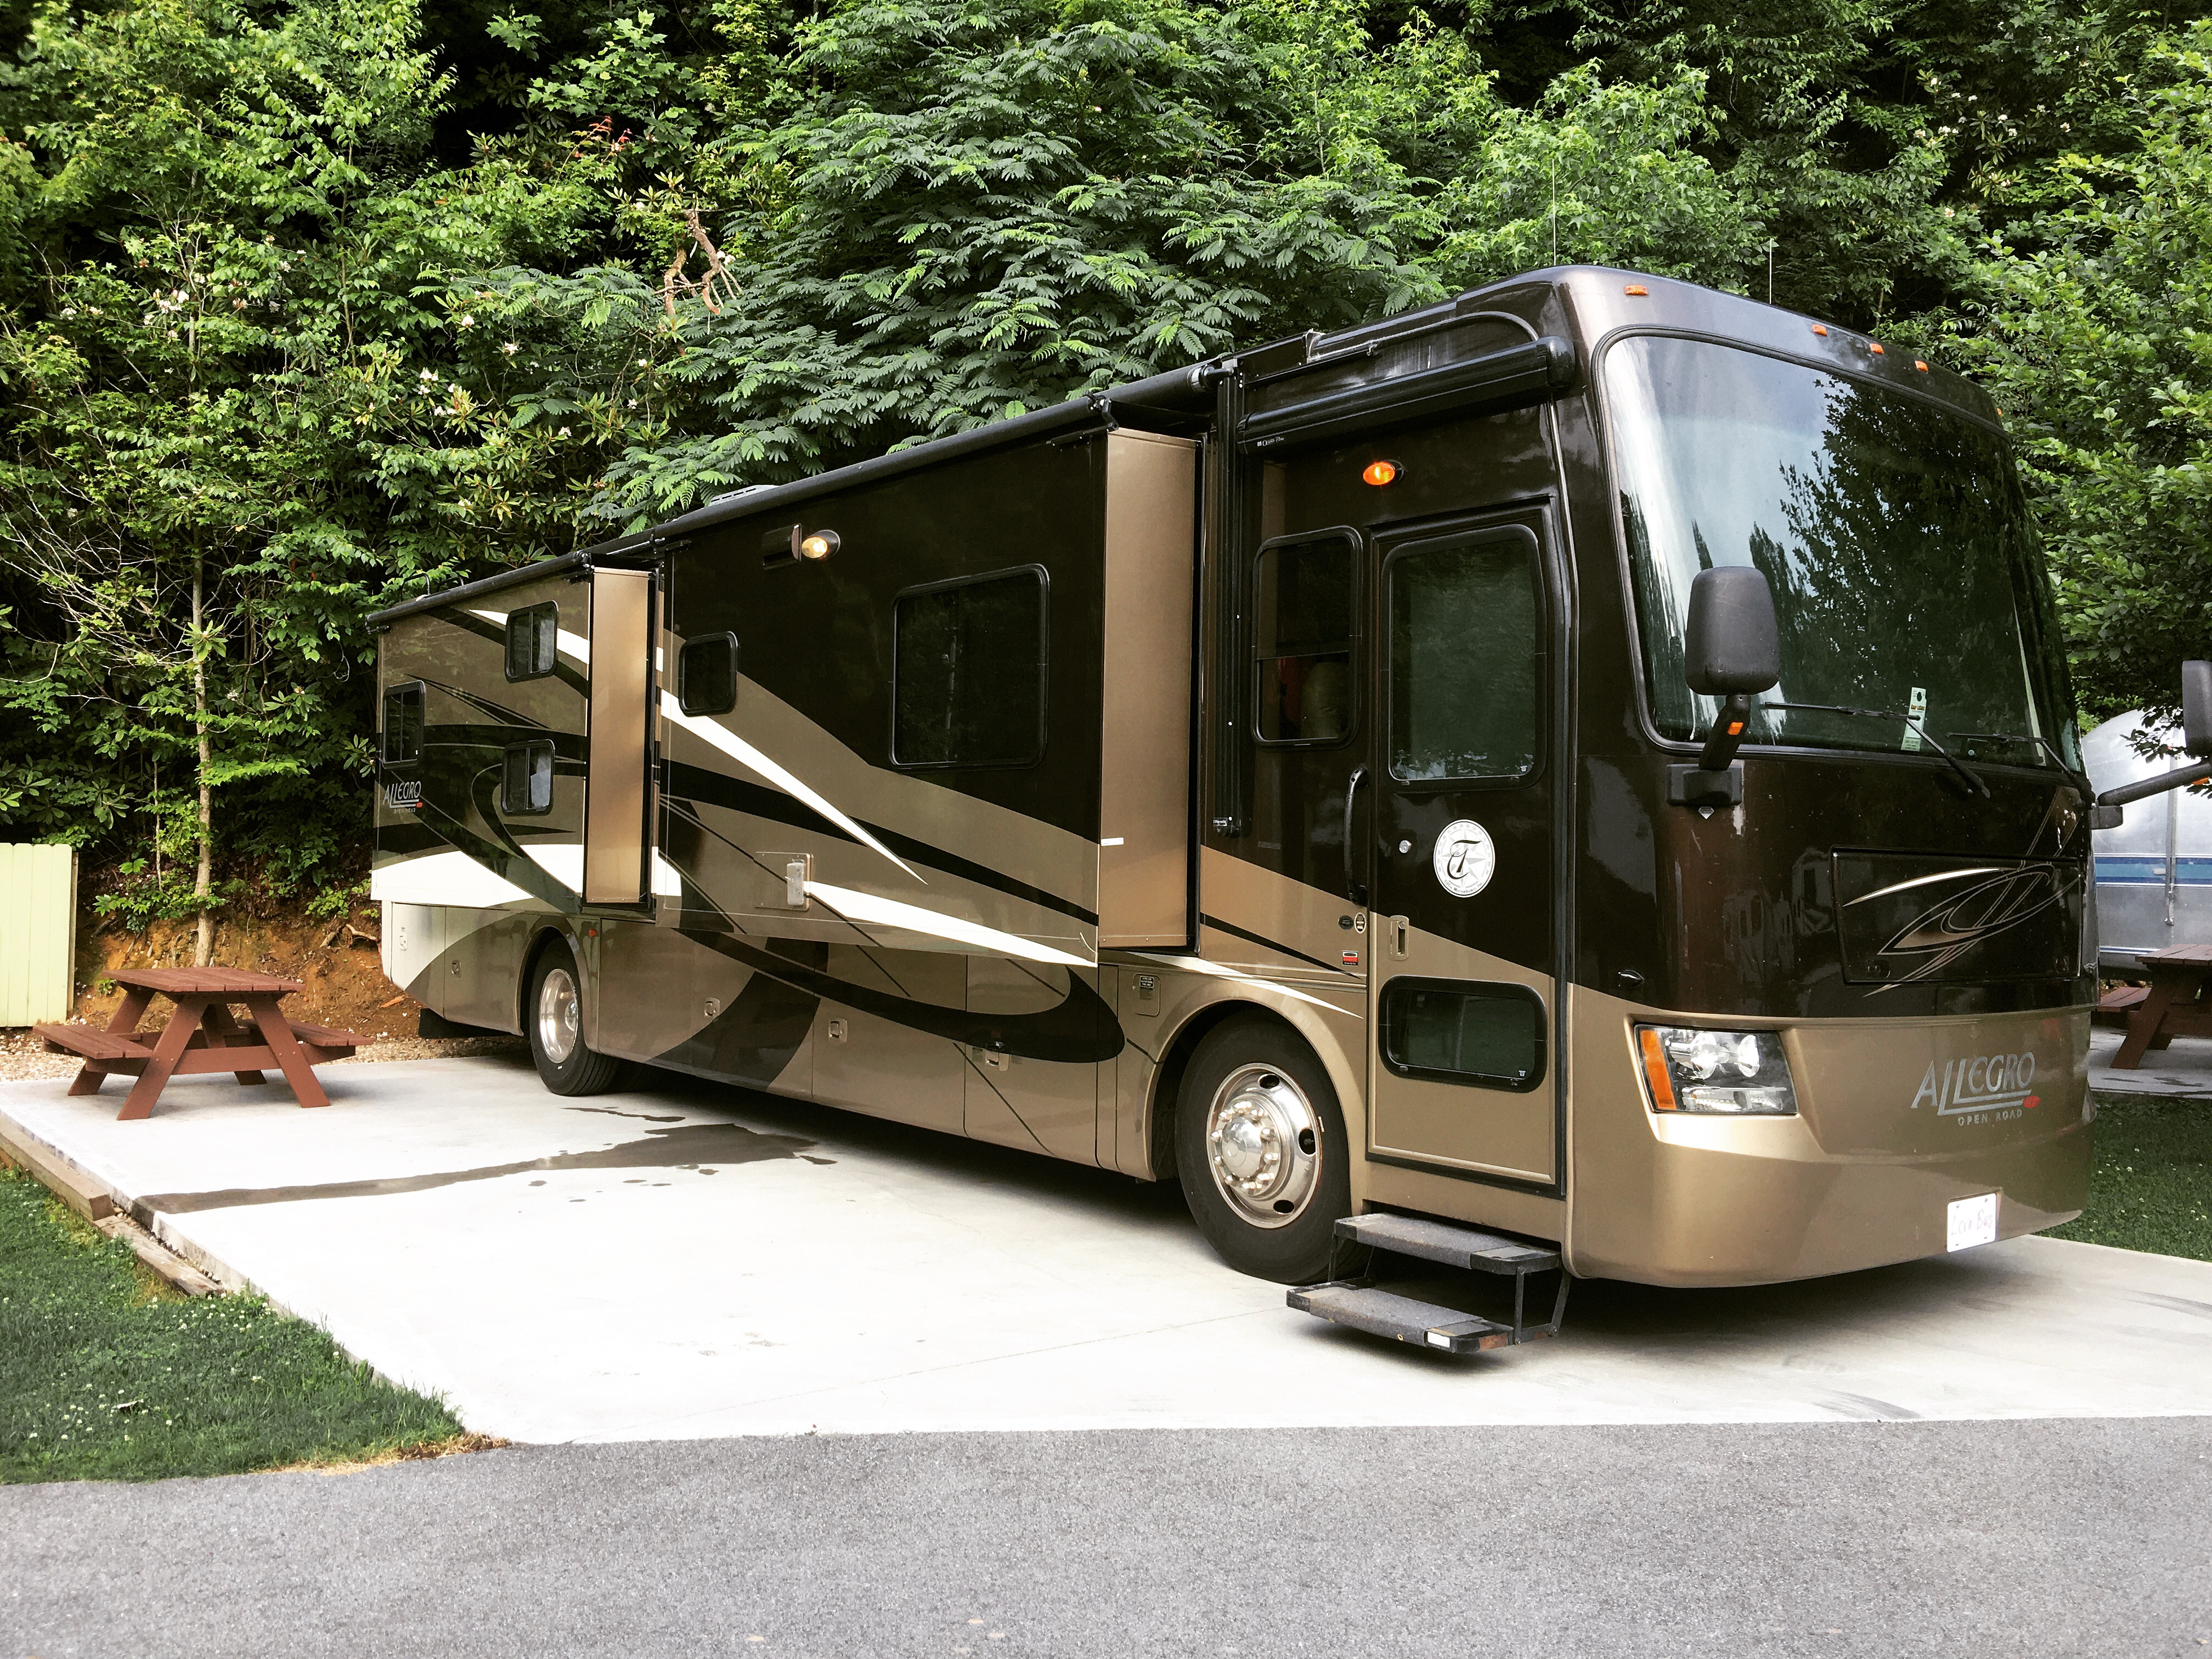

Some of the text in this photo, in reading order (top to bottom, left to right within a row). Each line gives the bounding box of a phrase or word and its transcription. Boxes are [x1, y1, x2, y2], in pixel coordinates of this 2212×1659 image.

[382, 781, 421, 809] ALLEGRO
[1911, 1052, 2035, 1116] ALLEGRO
[1957, 1109, 2022, 1126] OPEN ROAD
[1977, 1209, 1993, 1230] Bus
